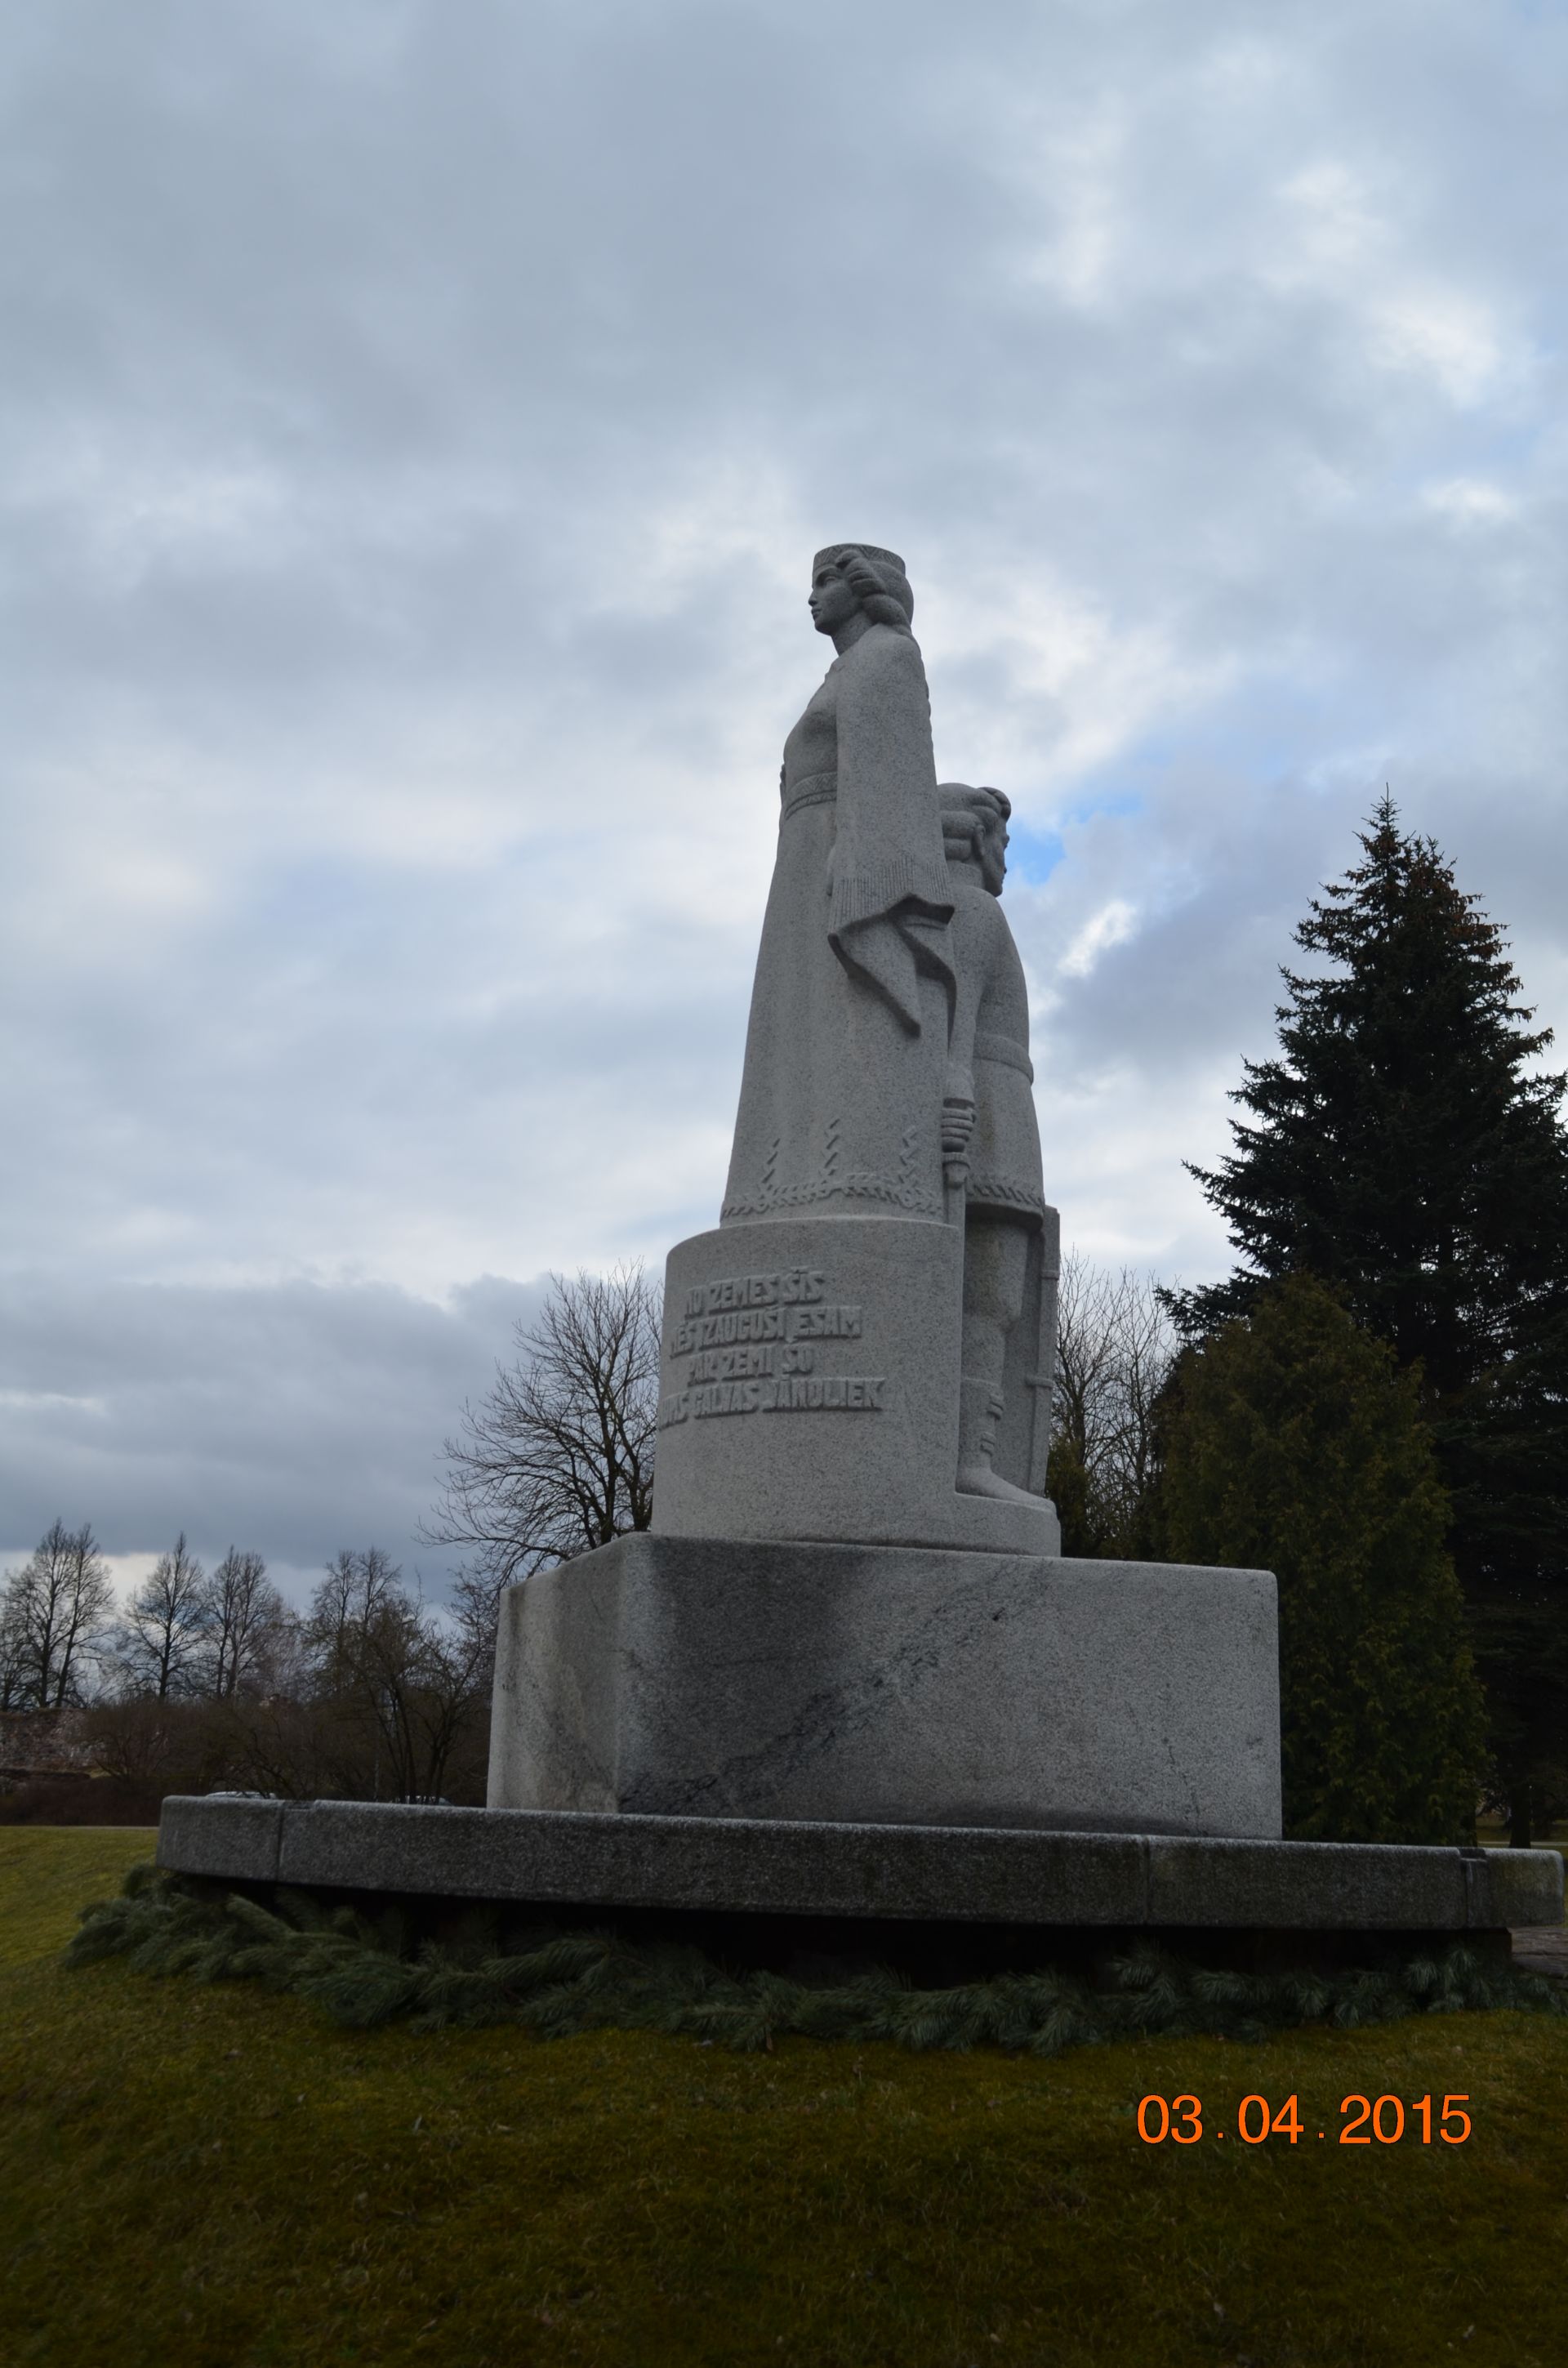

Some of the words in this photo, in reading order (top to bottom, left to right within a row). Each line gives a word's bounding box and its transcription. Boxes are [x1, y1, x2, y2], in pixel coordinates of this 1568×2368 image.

[708, 1273, 780, 1313] ZEMES
[793, 1305, 862, 1340] ESAM
[721, 1344, 774, 1382] ZEMI
